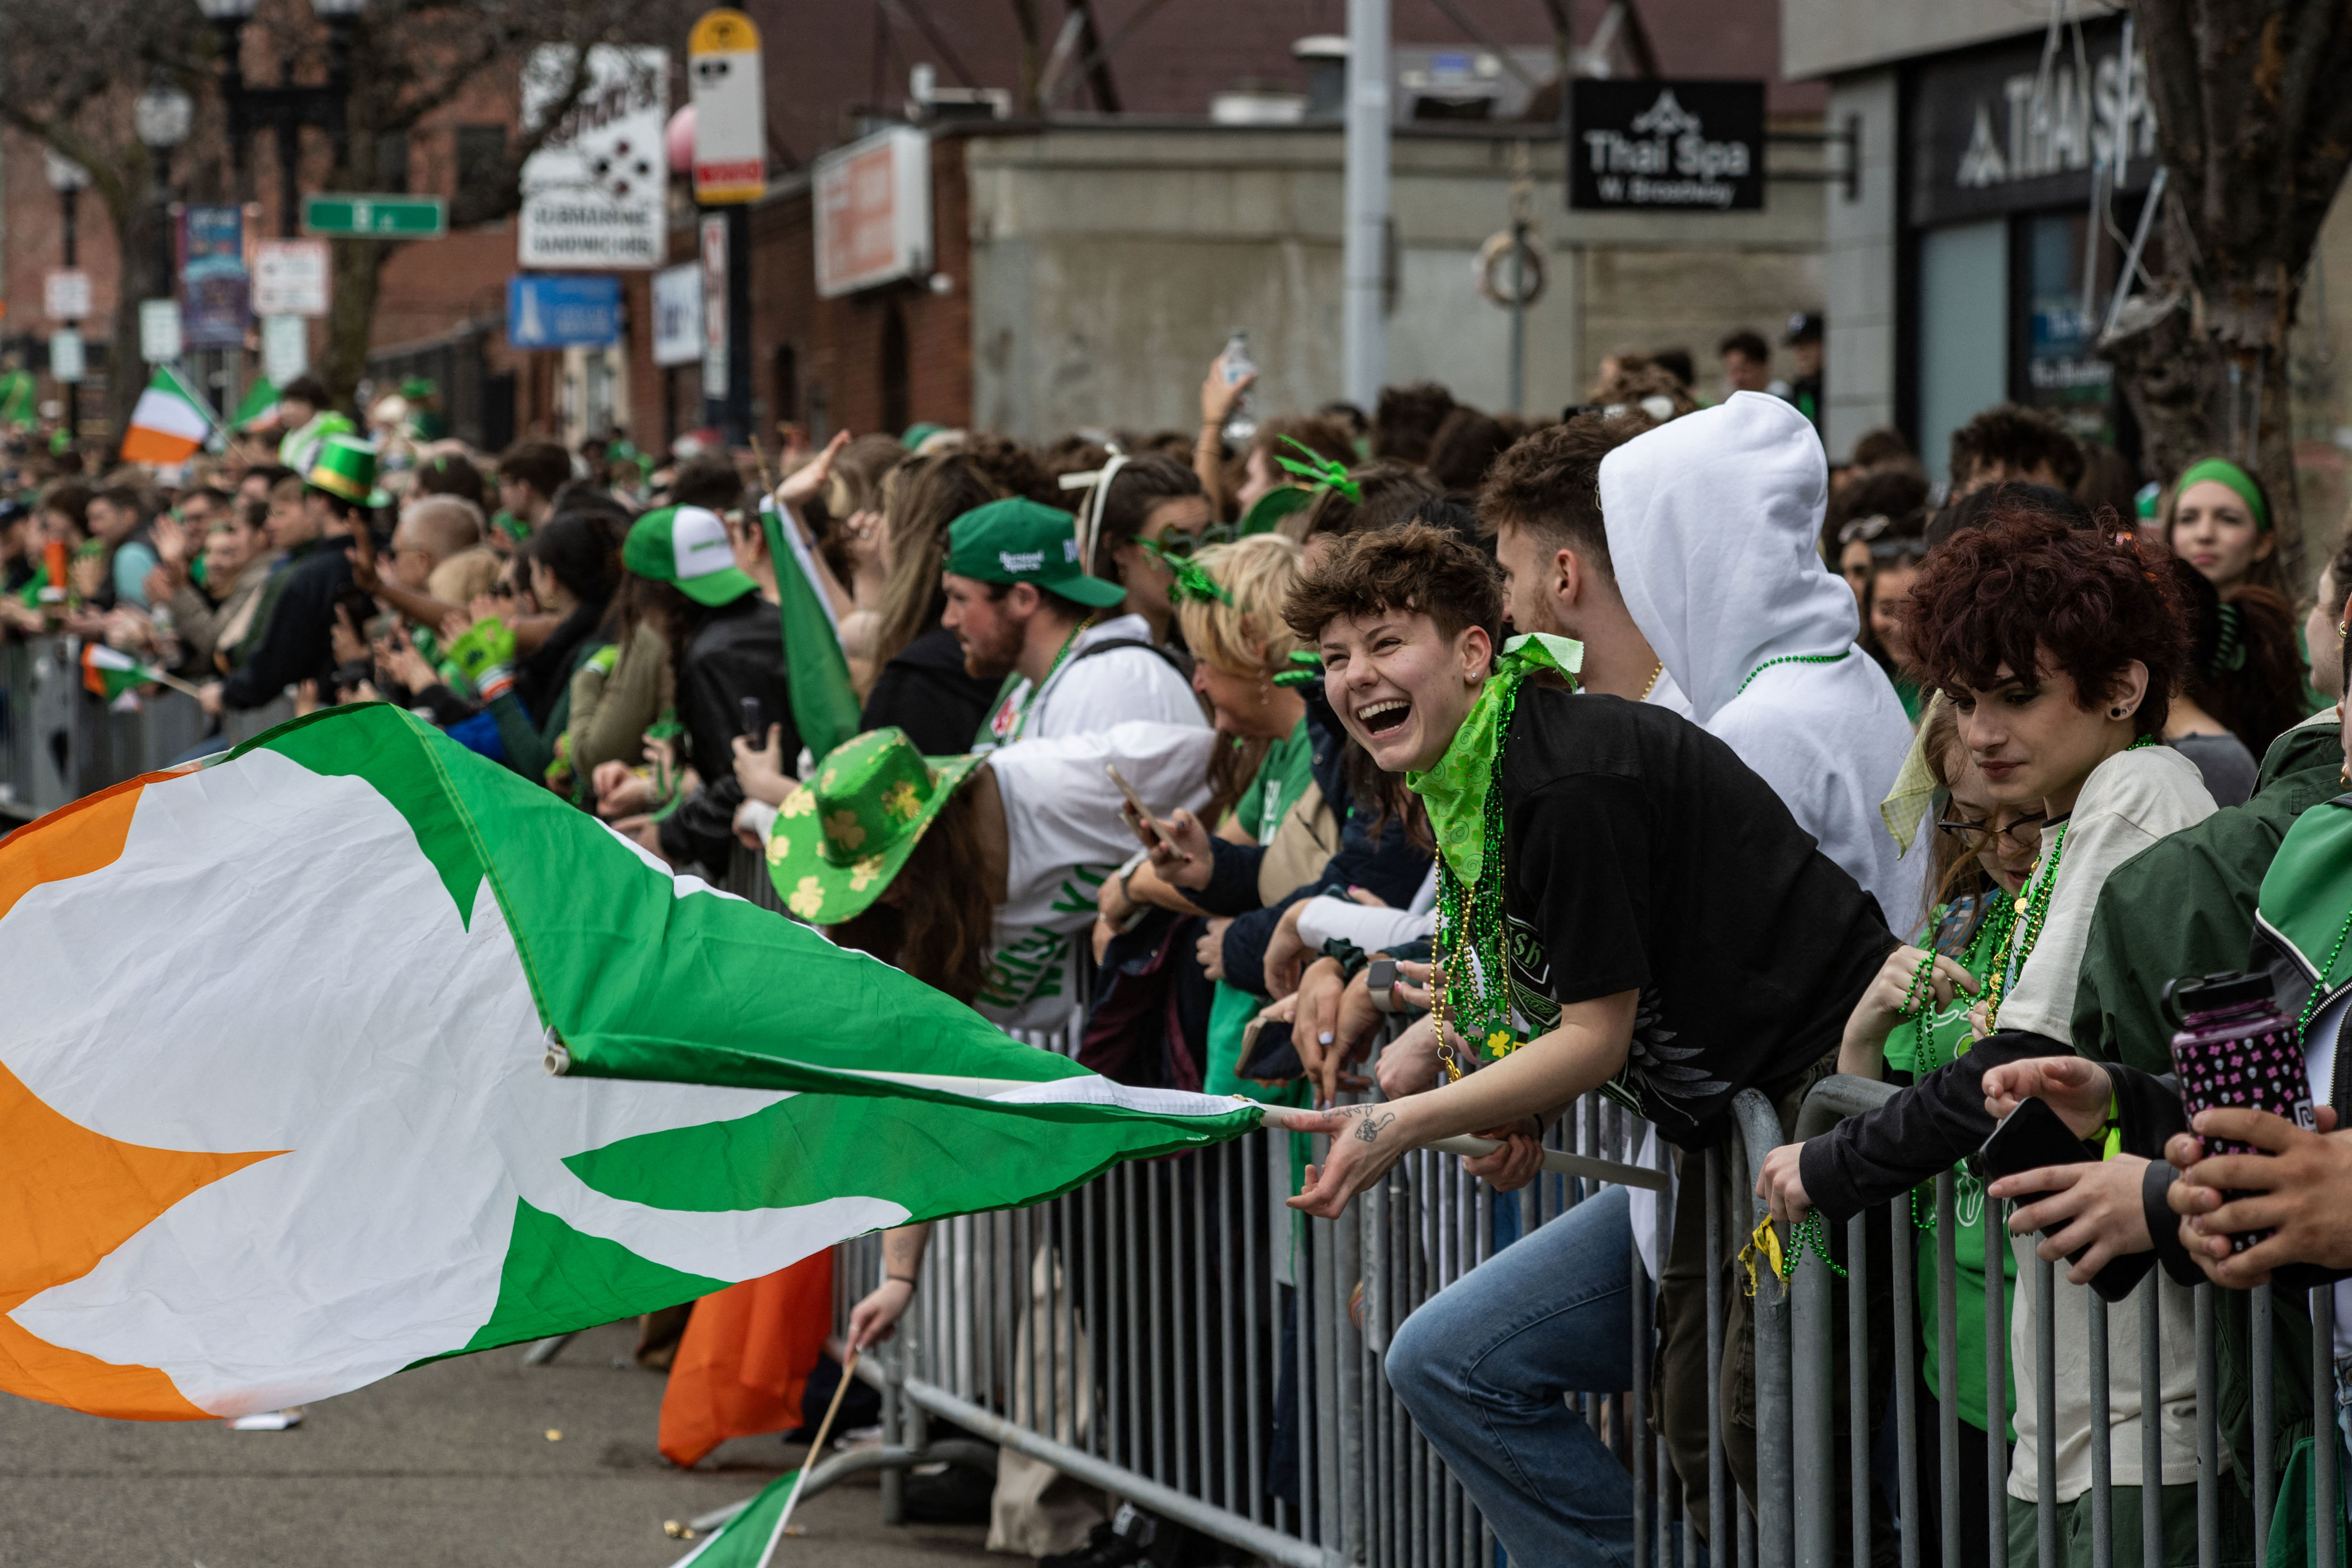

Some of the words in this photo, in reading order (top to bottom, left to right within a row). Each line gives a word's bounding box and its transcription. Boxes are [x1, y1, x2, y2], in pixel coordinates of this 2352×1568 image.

[1584, 130, 1669, 174] Thai
[1675, 135, 1750, 183] Spa
[1626, 177, 1736, 208] Broadway
[532, 232, 652, 254] SANDWICHES
